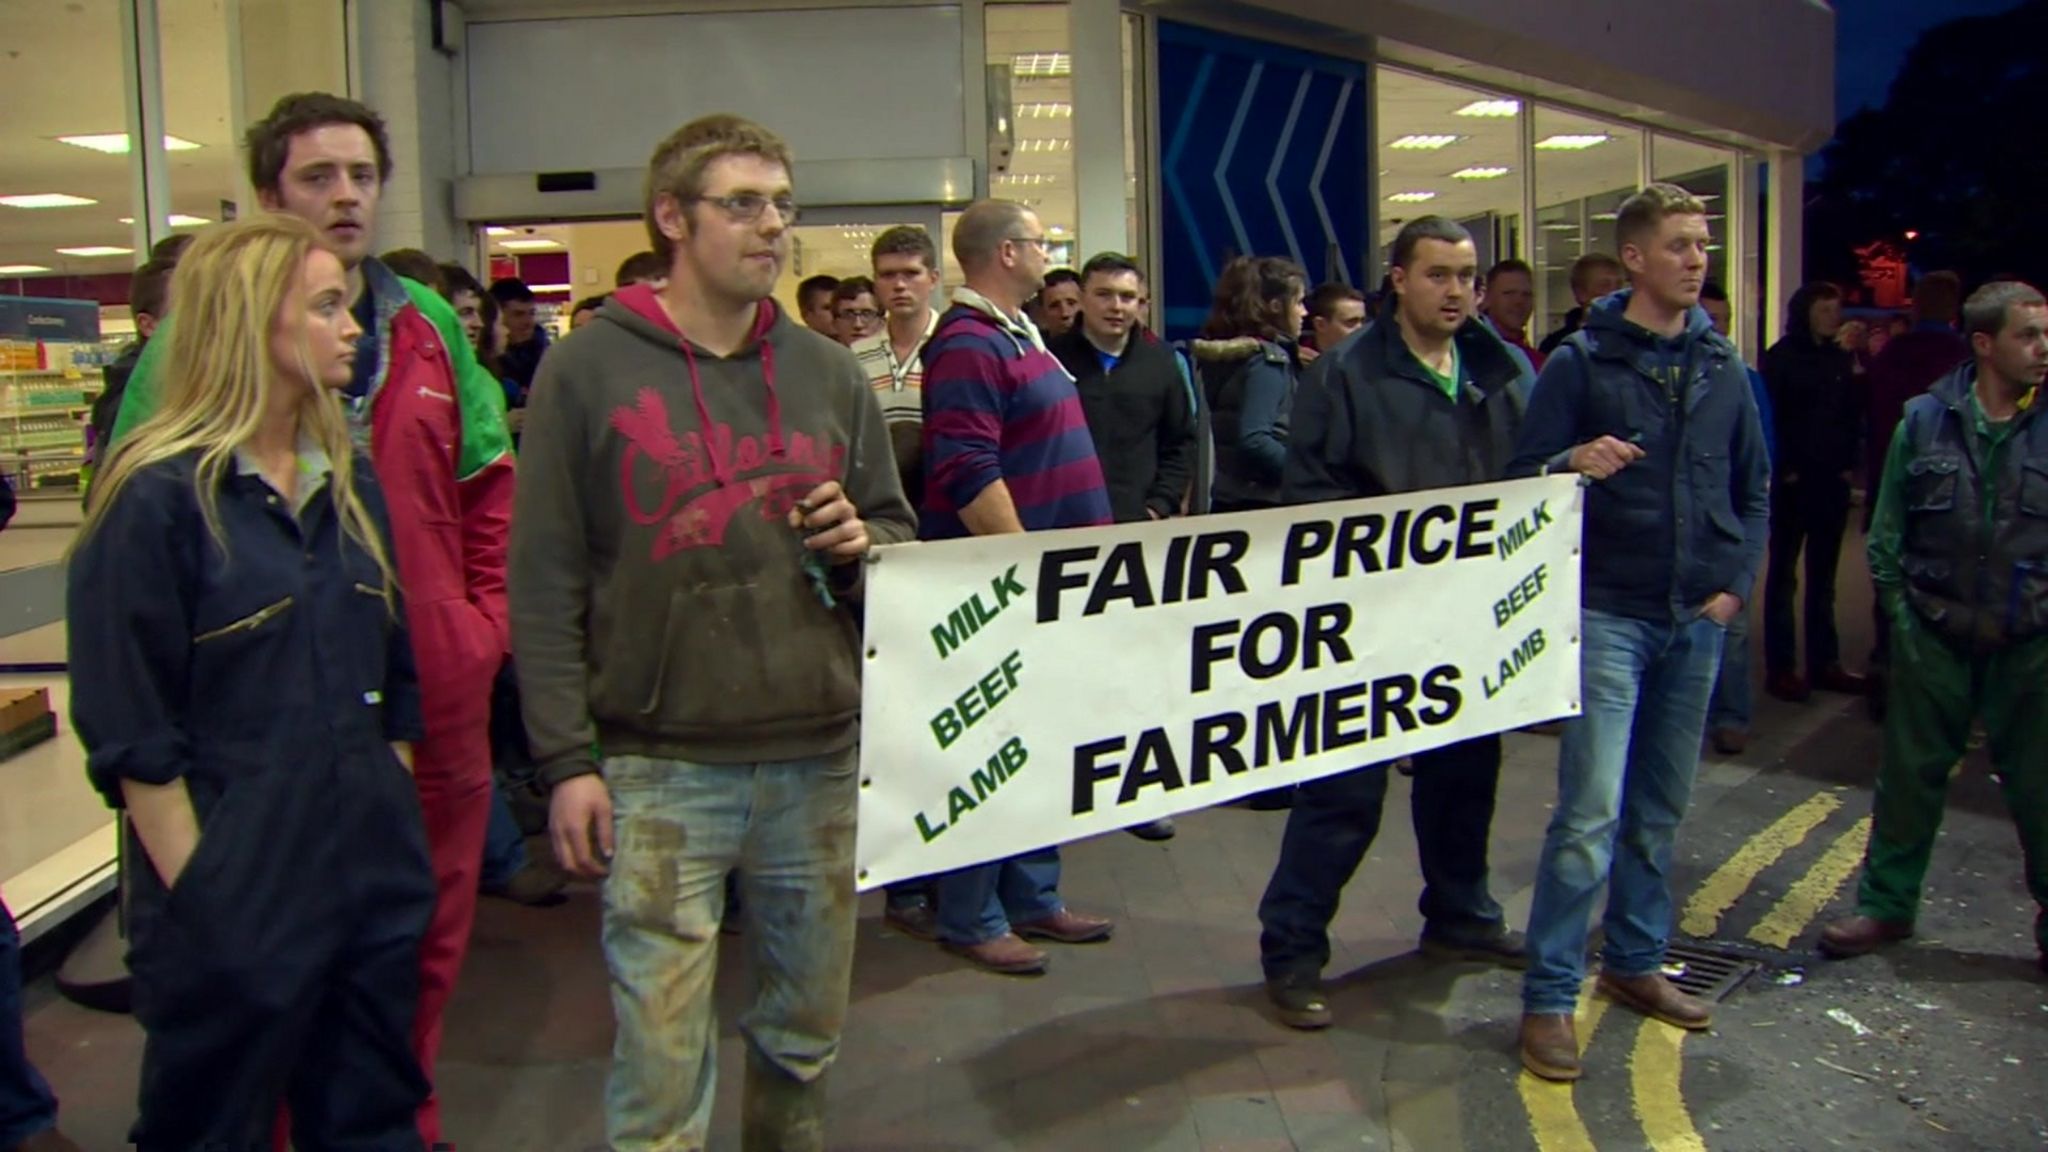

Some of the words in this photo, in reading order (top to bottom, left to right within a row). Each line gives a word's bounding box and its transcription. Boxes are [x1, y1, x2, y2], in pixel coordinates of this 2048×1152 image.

[1036, 530, 1250, 624] FAIR
[1281, 498, 1500, 587] PRICE
[1497, 501, 1552, 560] MILK
[931, 565, 1026, 658] MILK
[1493, 564, 1546, 628] BEEF
[1189, 602, 1354, 694] FOR
[1482, 628, 1545, 699] LAMB
[930, 650, 1022, 749] BEEF
[1071, 664, 1462, 816] FARMERS
[914, 736, 1028, 843] LAMB
